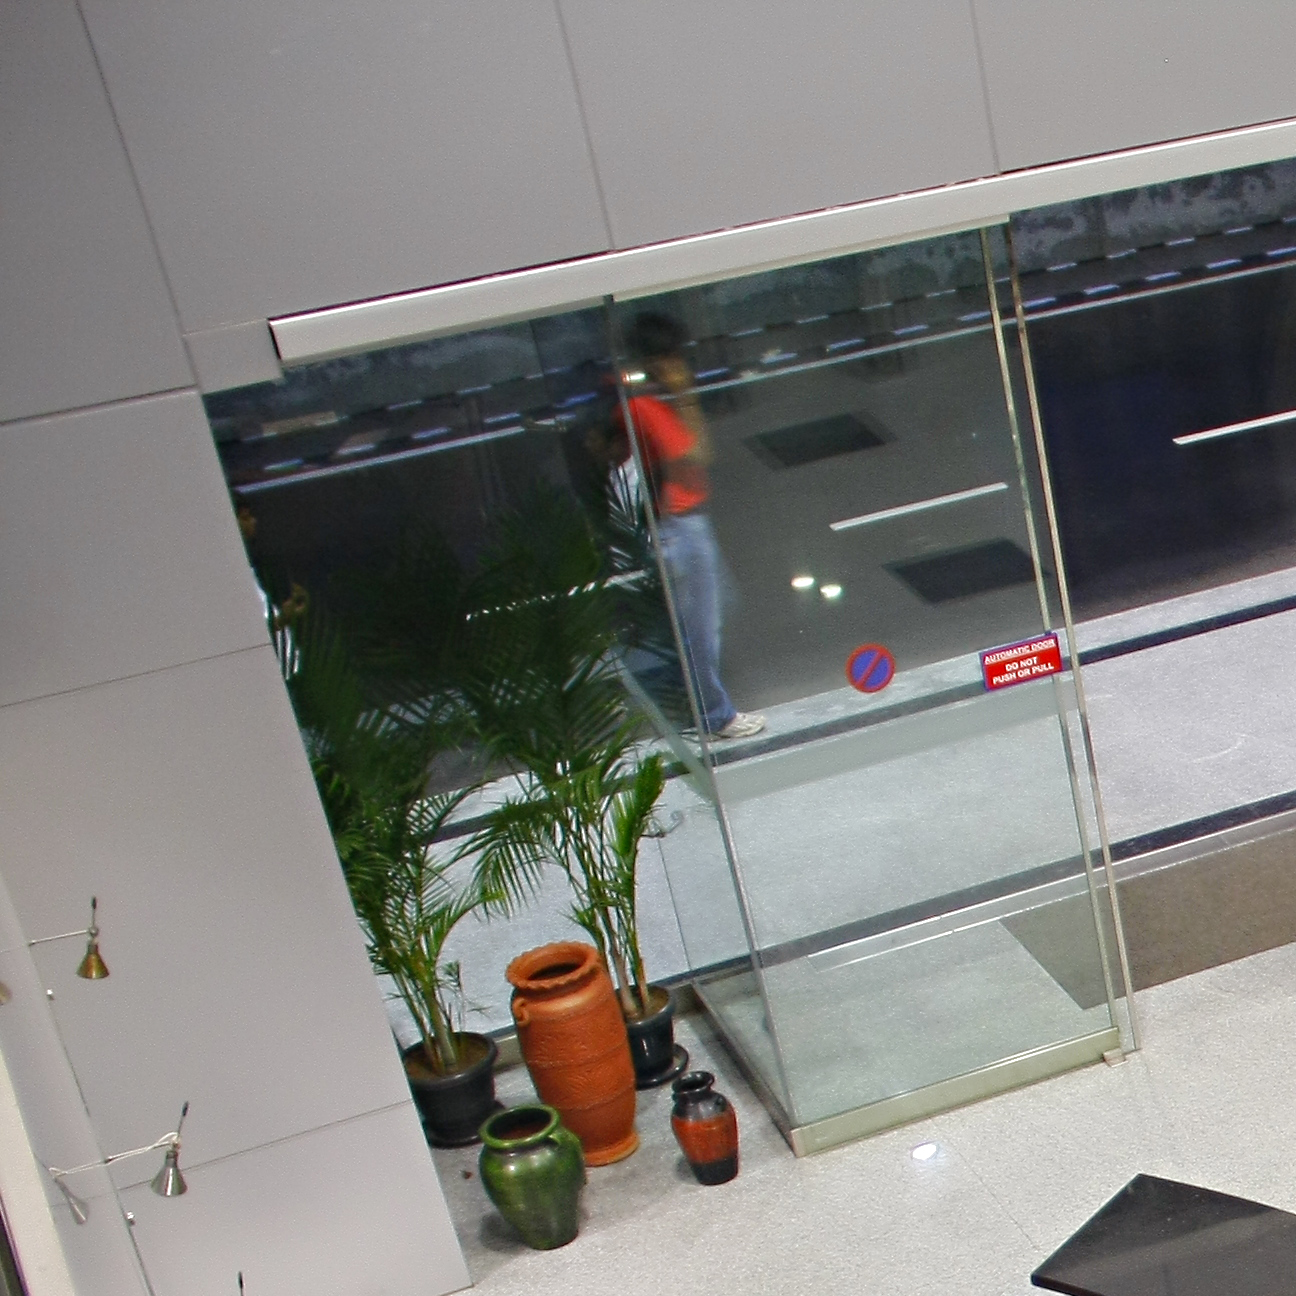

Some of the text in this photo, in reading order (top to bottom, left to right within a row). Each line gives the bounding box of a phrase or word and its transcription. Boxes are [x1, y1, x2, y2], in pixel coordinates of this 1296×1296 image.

[984, 638, 1056, 664] AUTOMATIC DOOR
[992, 662, 1054, 685] PUSH OR PULL
[1005, 656, 1038, 672] DO NOT
